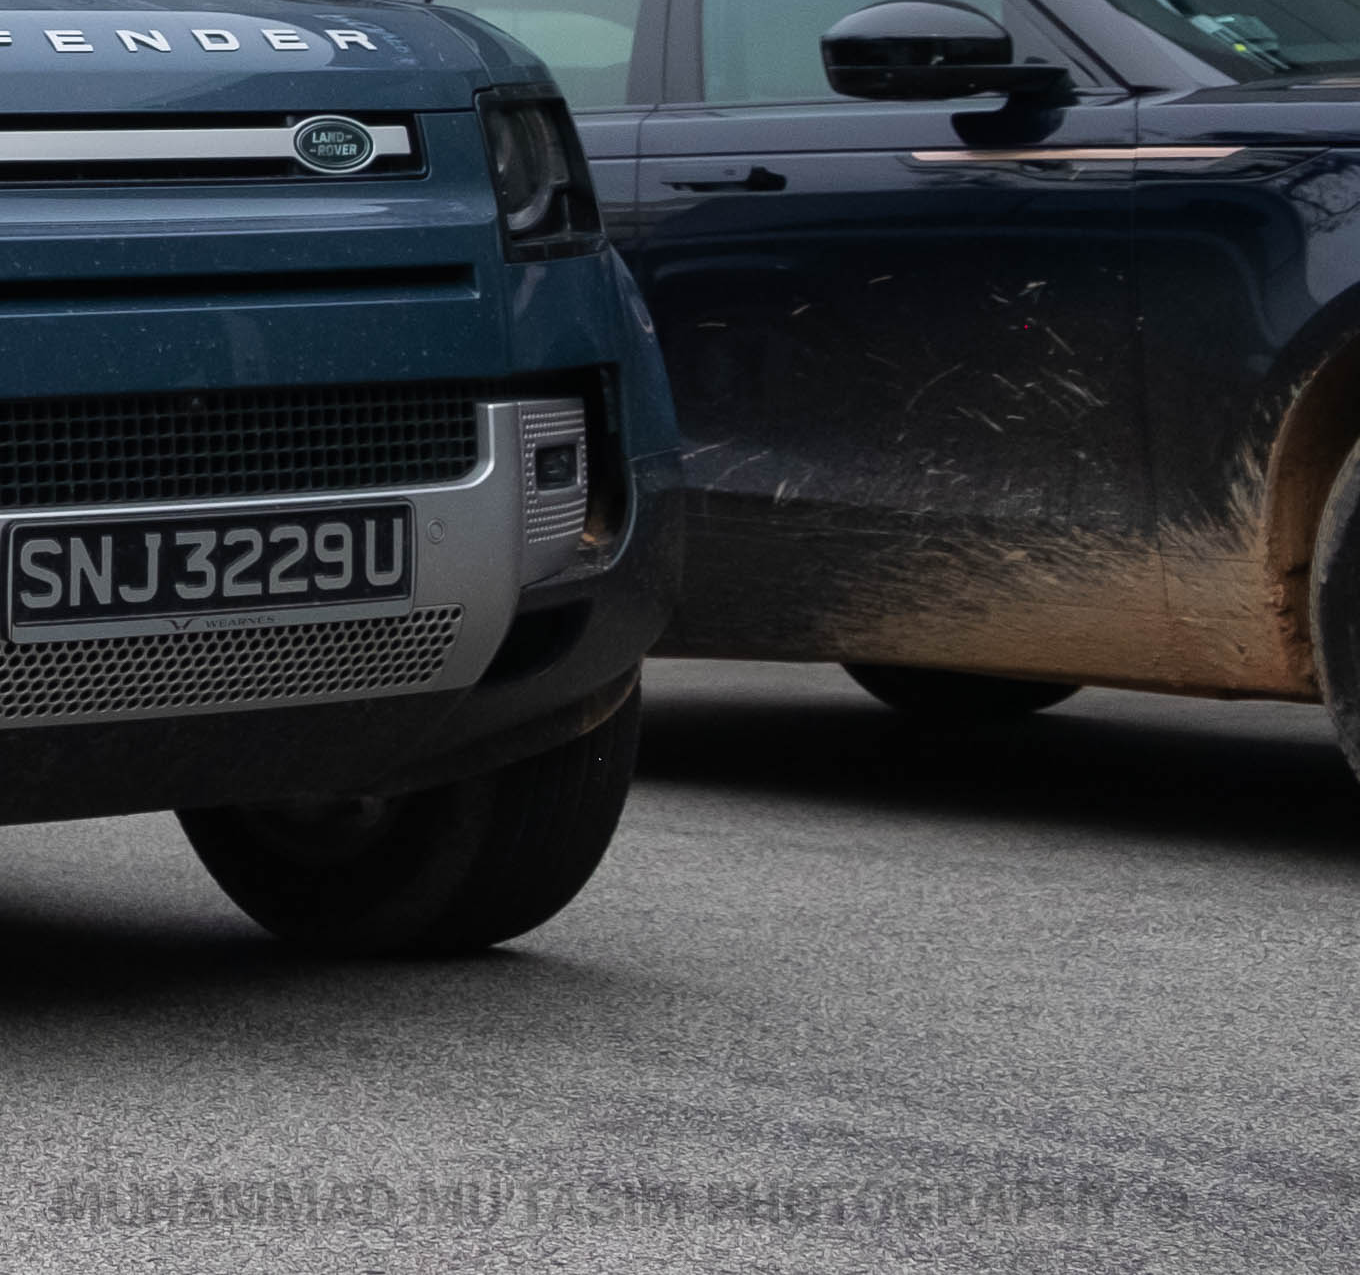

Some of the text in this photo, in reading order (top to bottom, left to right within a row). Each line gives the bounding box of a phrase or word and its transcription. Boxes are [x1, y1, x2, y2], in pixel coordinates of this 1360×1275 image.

[311, 131, 345, 144] LAND
[317, 143, 358, 156] ROVER
[19, 517, 404, 610] SNJ3229U
[204, 614, 276, 629] WEARNES
